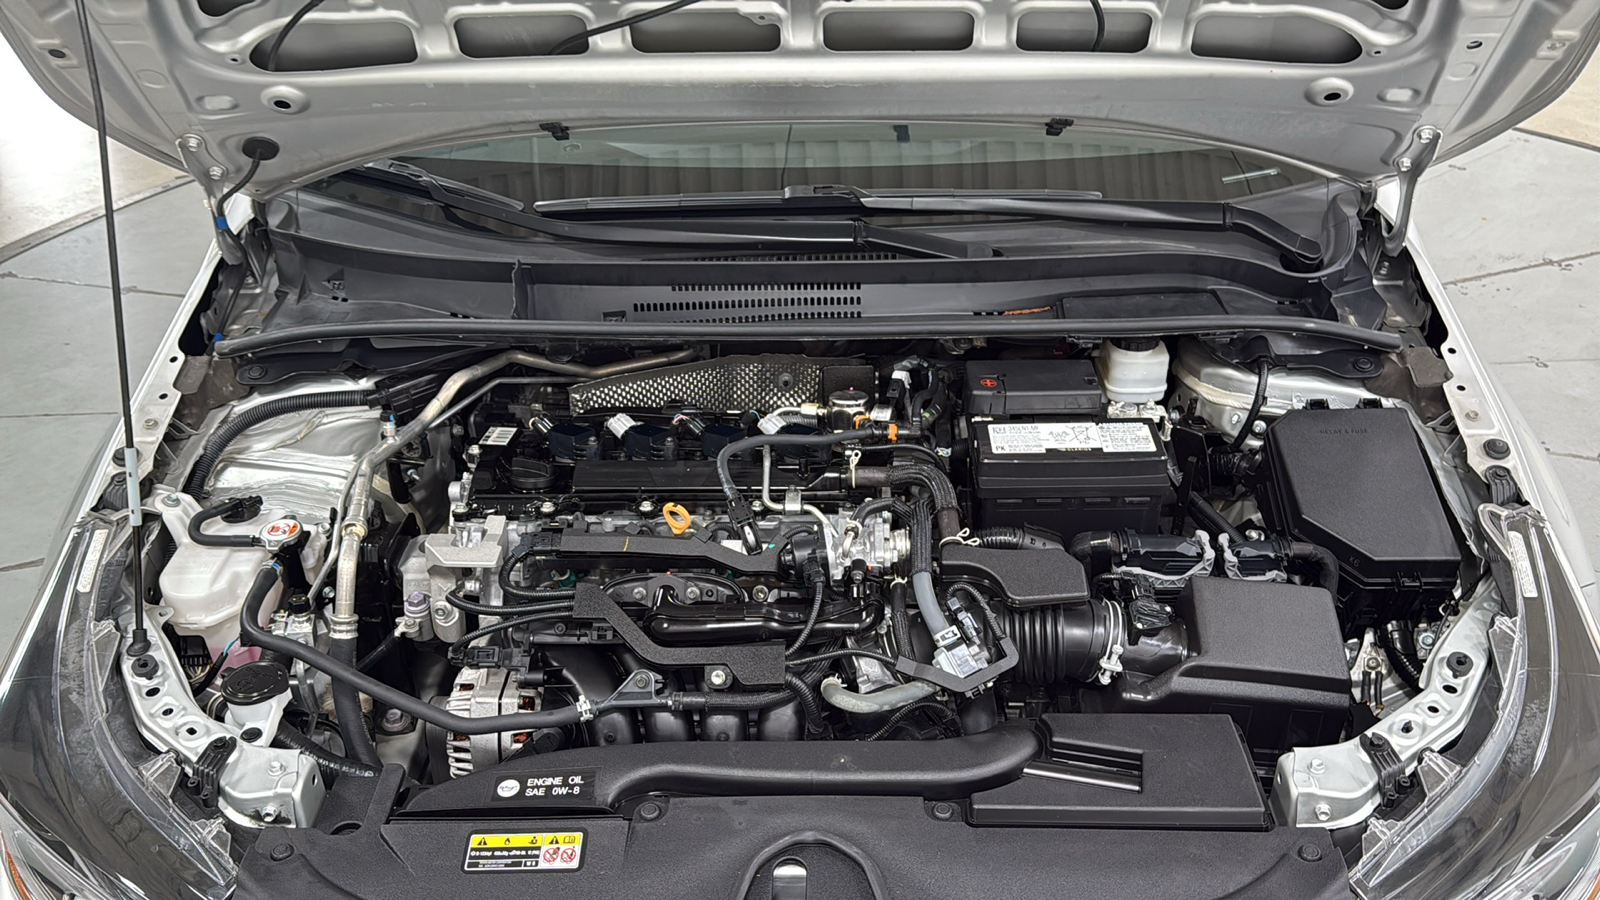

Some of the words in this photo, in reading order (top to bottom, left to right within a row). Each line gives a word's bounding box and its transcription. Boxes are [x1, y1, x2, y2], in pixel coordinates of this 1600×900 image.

[1348, 555, 1361, 568] K6
[526, 776, 564, 787] ENGINE
[568, 775, 585, 785] OIL
[524, 787, 546, 797] SAE
[551, 786, 581, 796] 0W-8
